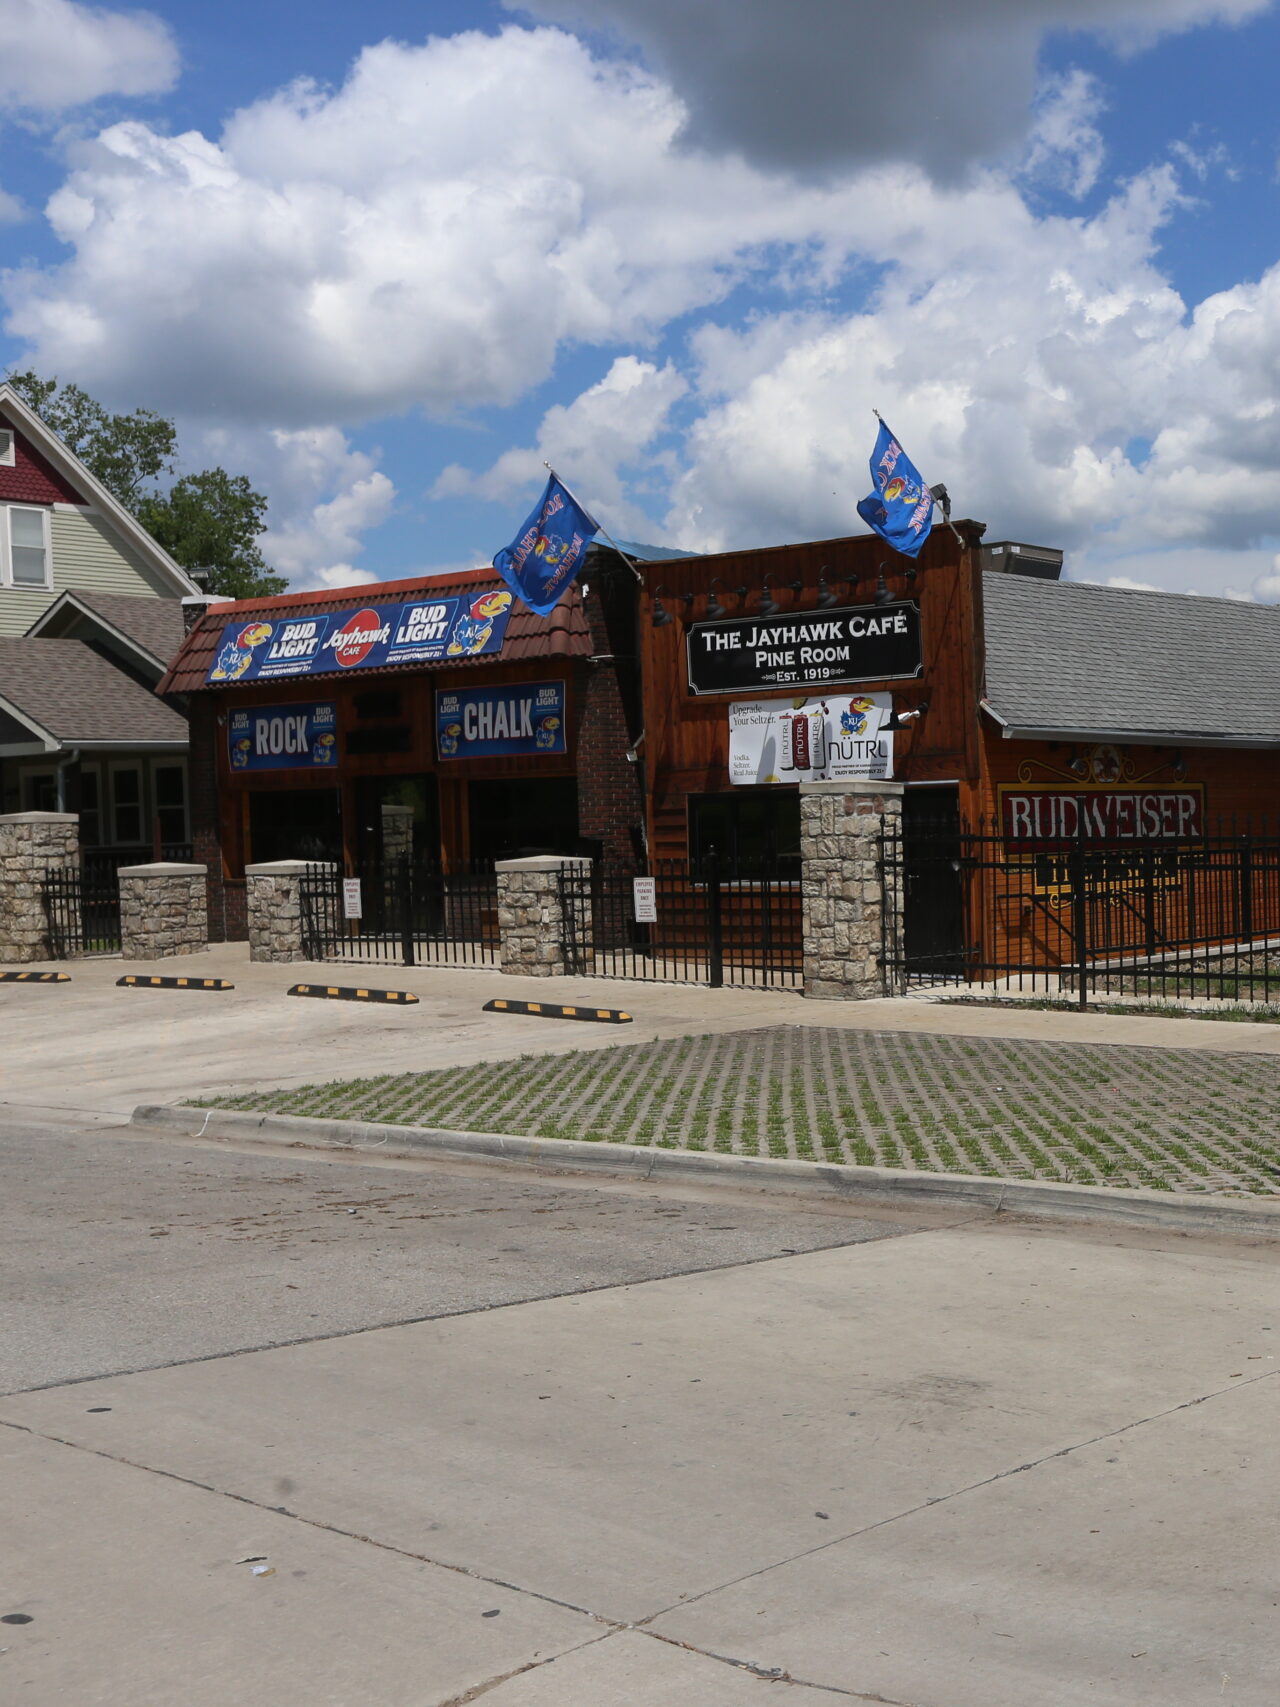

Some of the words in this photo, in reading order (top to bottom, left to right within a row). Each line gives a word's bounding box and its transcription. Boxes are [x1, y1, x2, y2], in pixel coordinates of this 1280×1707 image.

[408, 605, 447, 625] BUD
[280, 622, 317, 641] BUD
[322, 623, 391, 651] Jayhawk
[395, 621, 448, 644] LIGHT
[702, 631, 742, 652] THE
[746, 620, 843, 648] JAYHAWK
[849, 610, 908, 638] CAFÉ
[268, 638, 318, 659] LIGHT
[342, 646, 361, 656] CAFE
[755, 651, 795, 668] PINE
[800, 646, 850, 664] ROOM
[776, 671, 800, 682] EST.
[804, 667, 830, 680] 1919
[539, 689, 556, 697] BUD
[440, 704, 460, 713] LIGHT
[443, 697, 458, 705] BUD
[536, 696, 559, 706] LIGHT
[315, 707, 331, 715] BUD
[732, 704, 762, 716] Upgrade
[232, 720, 249, 729] LIGHT
[312, 714, 334, 723] LIGHT
[464, 698, 533, 740] CHALK
[733, 717, 749, 726] Your
[749, 716, 776, 725] Seltzer.
[255, 715, 309, 755] ROCK
[1008, 794, 1200, 838] BUDWEISER
